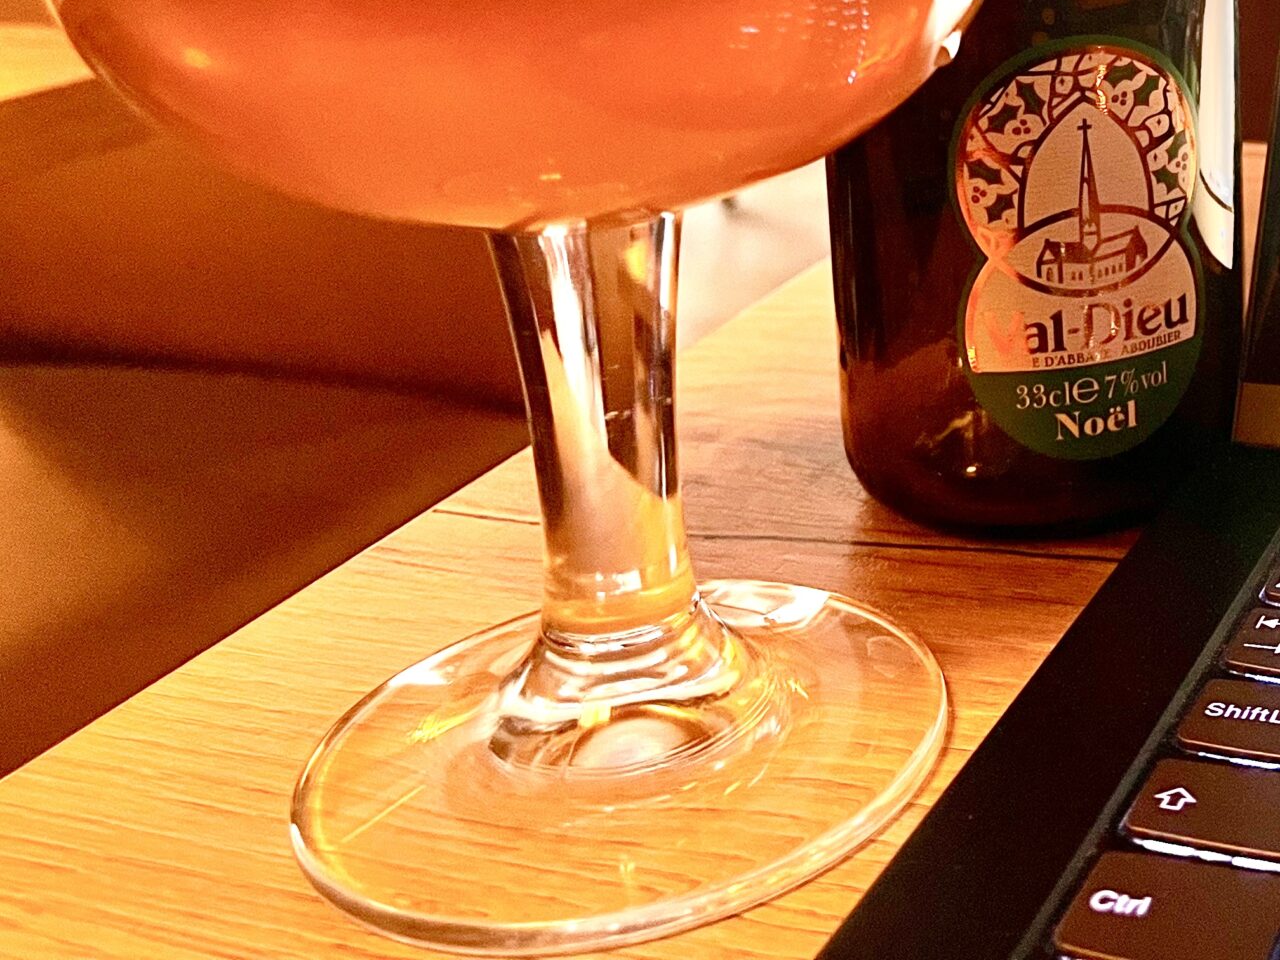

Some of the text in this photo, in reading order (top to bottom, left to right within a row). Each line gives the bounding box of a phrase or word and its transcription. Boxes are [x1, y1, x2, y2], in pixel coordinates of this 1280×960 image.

[1044, 347, 1113, 368] D'ABBAE
[1055, 399, 1137, 440] Noël
[1089, 889, 1152, 917] Ctrl
